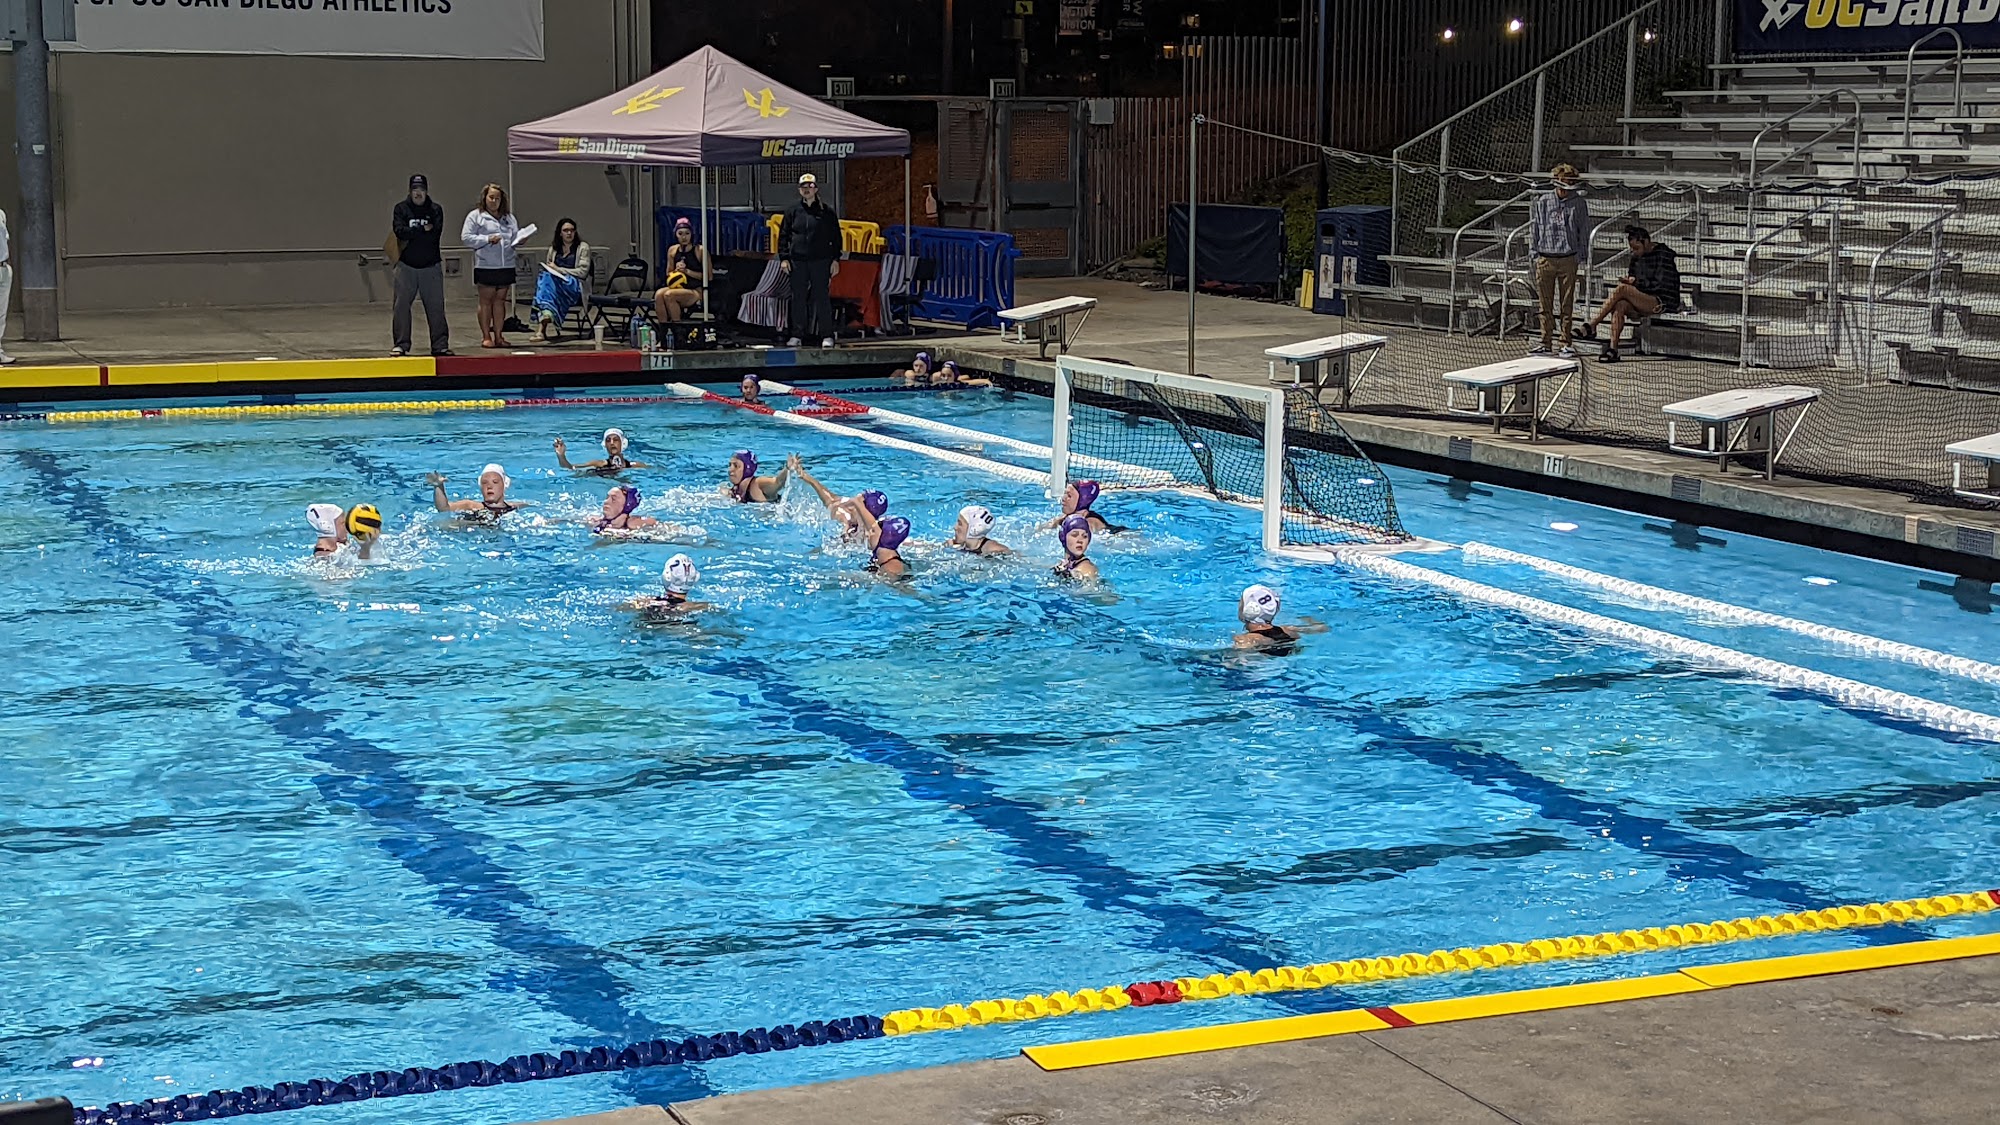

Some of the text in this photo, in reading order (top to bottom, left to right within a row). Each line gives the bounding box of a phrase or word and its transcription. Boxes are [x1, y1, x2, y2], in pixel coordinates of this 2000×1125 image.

[834, 81, 852, 95] EXIT
[996, 83, 1012, 96] EXIT
[1048, 324, 1057, 336] 10
[653, 355, 673, 368] 7 FT
[1333, 362, 1339, 376] 6
[1521, 390, 1528, 405] 5
[1753, 425, 1761, 443] 4
[1546, 456, 1563, 474] 7 FT
[877, 494, 887, 505] 5
[979, 510, 994, 525] 10
[891, 518, 909, 534] 21
[1257, 594, 1272, 605] 8
